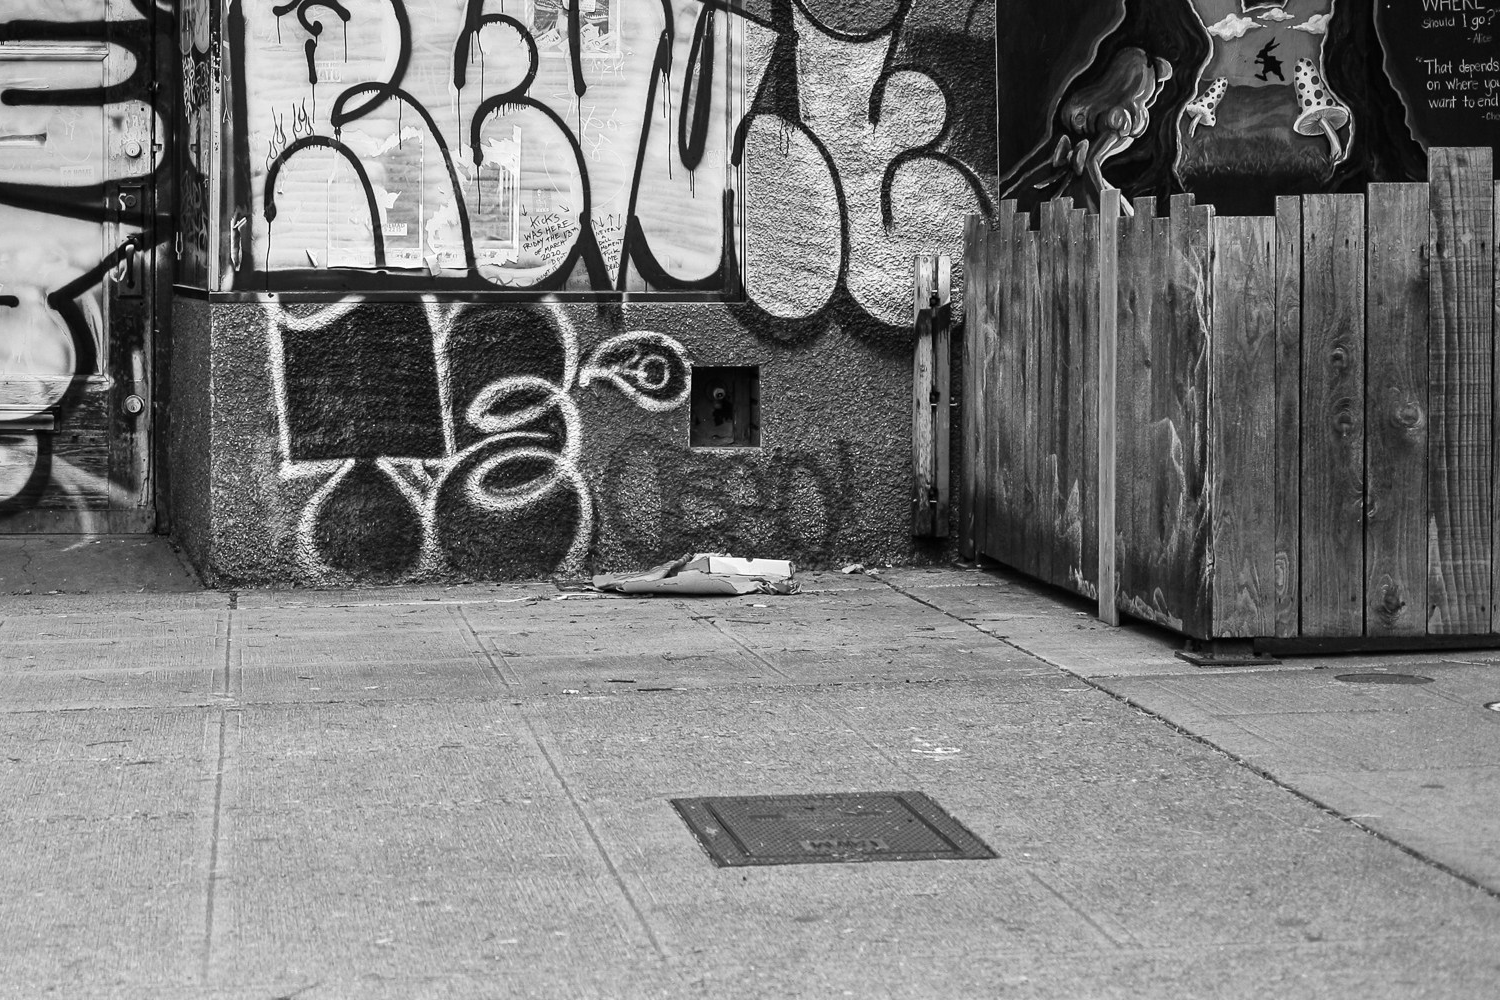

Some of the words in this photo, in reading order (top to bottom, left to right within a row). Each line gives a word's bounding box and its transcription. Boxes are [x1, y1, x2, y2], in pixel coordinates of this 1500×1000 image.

[1421, 17, 1455, 29] should
[1458, 57, 1500, 78] depends
[1427, 80, 1441, 91] on
[1445, 78, 1479, 90] where
[1428, 95, 1457, 109] want
[1462, 95, 1475, 108] to
[524, 229, 543, 241] WAS
[541, 250, 561, 261] 2020
